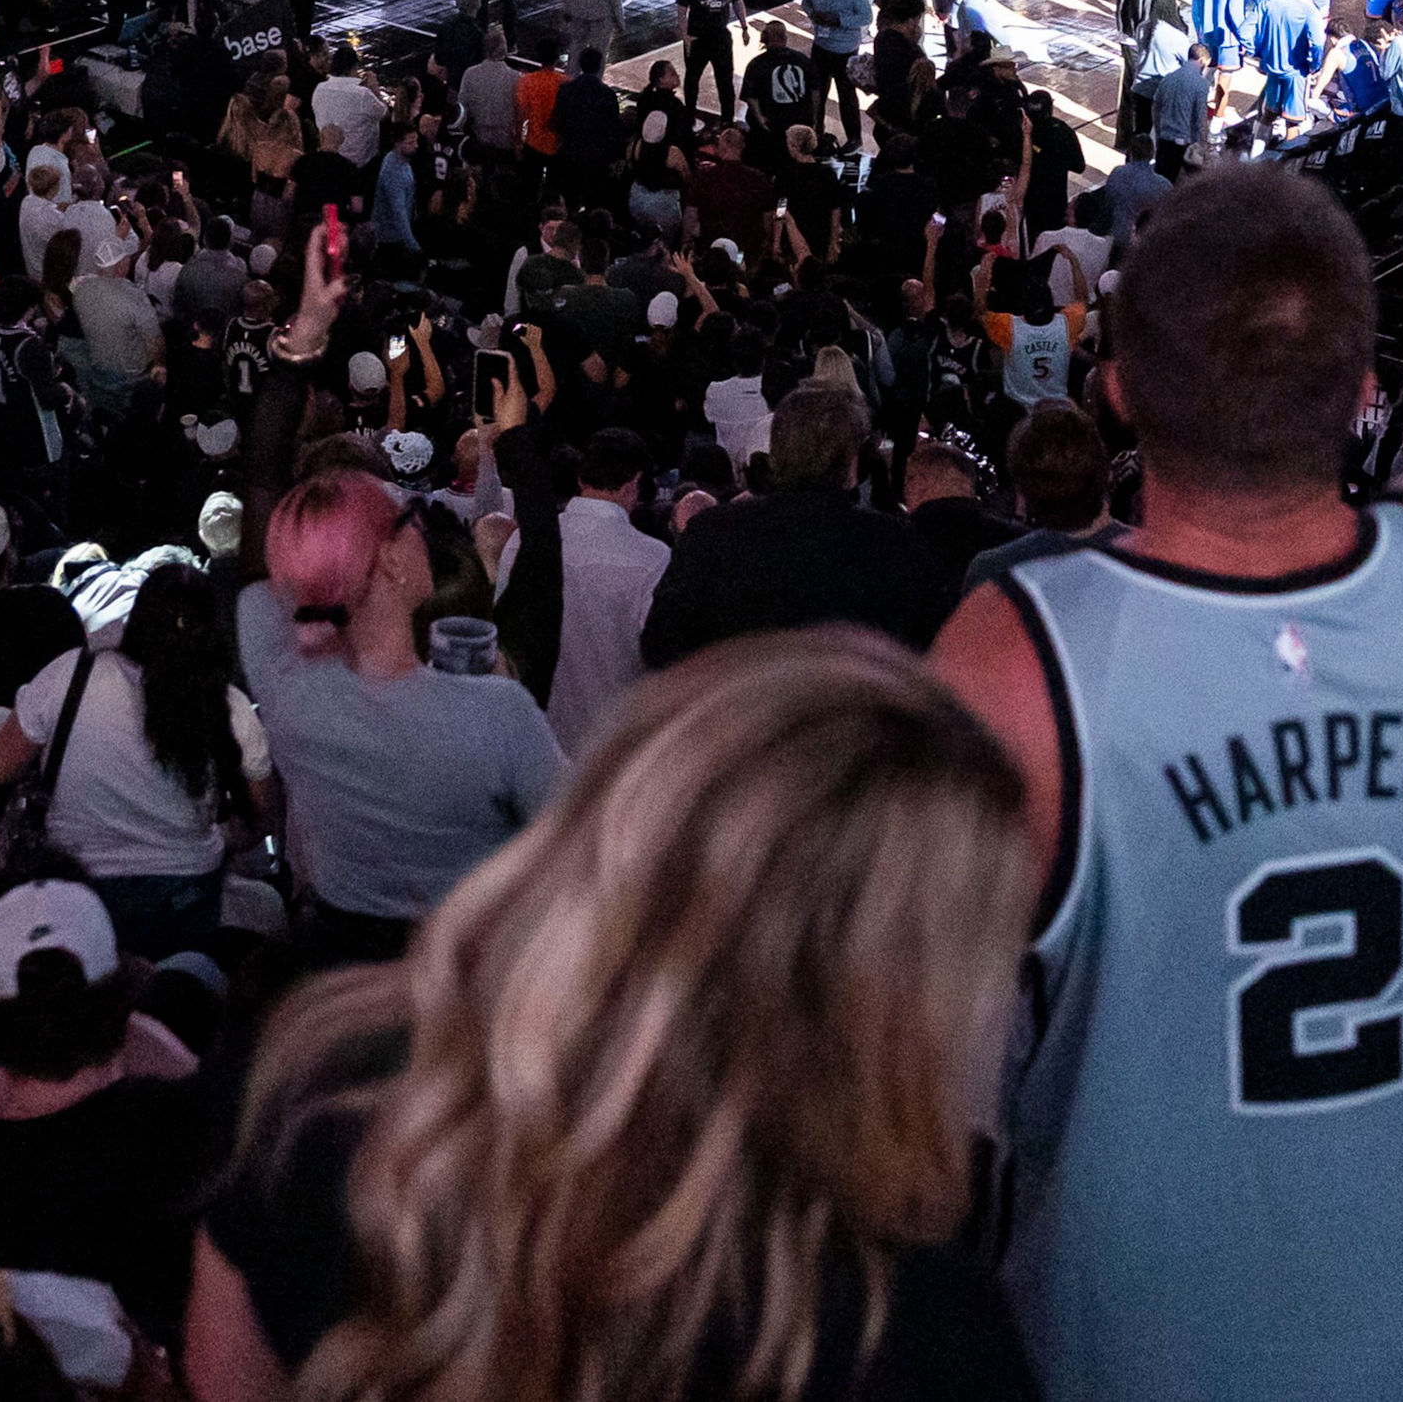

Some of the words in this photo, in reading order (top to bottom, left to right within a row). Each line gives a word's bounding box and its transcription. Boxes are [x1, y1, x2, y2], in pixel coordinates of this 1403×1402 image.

[1024, 341, 1059, 355] CASTLE
[237, 359, 254, 394] 1
[1032, 357, 1049, 379] 5
